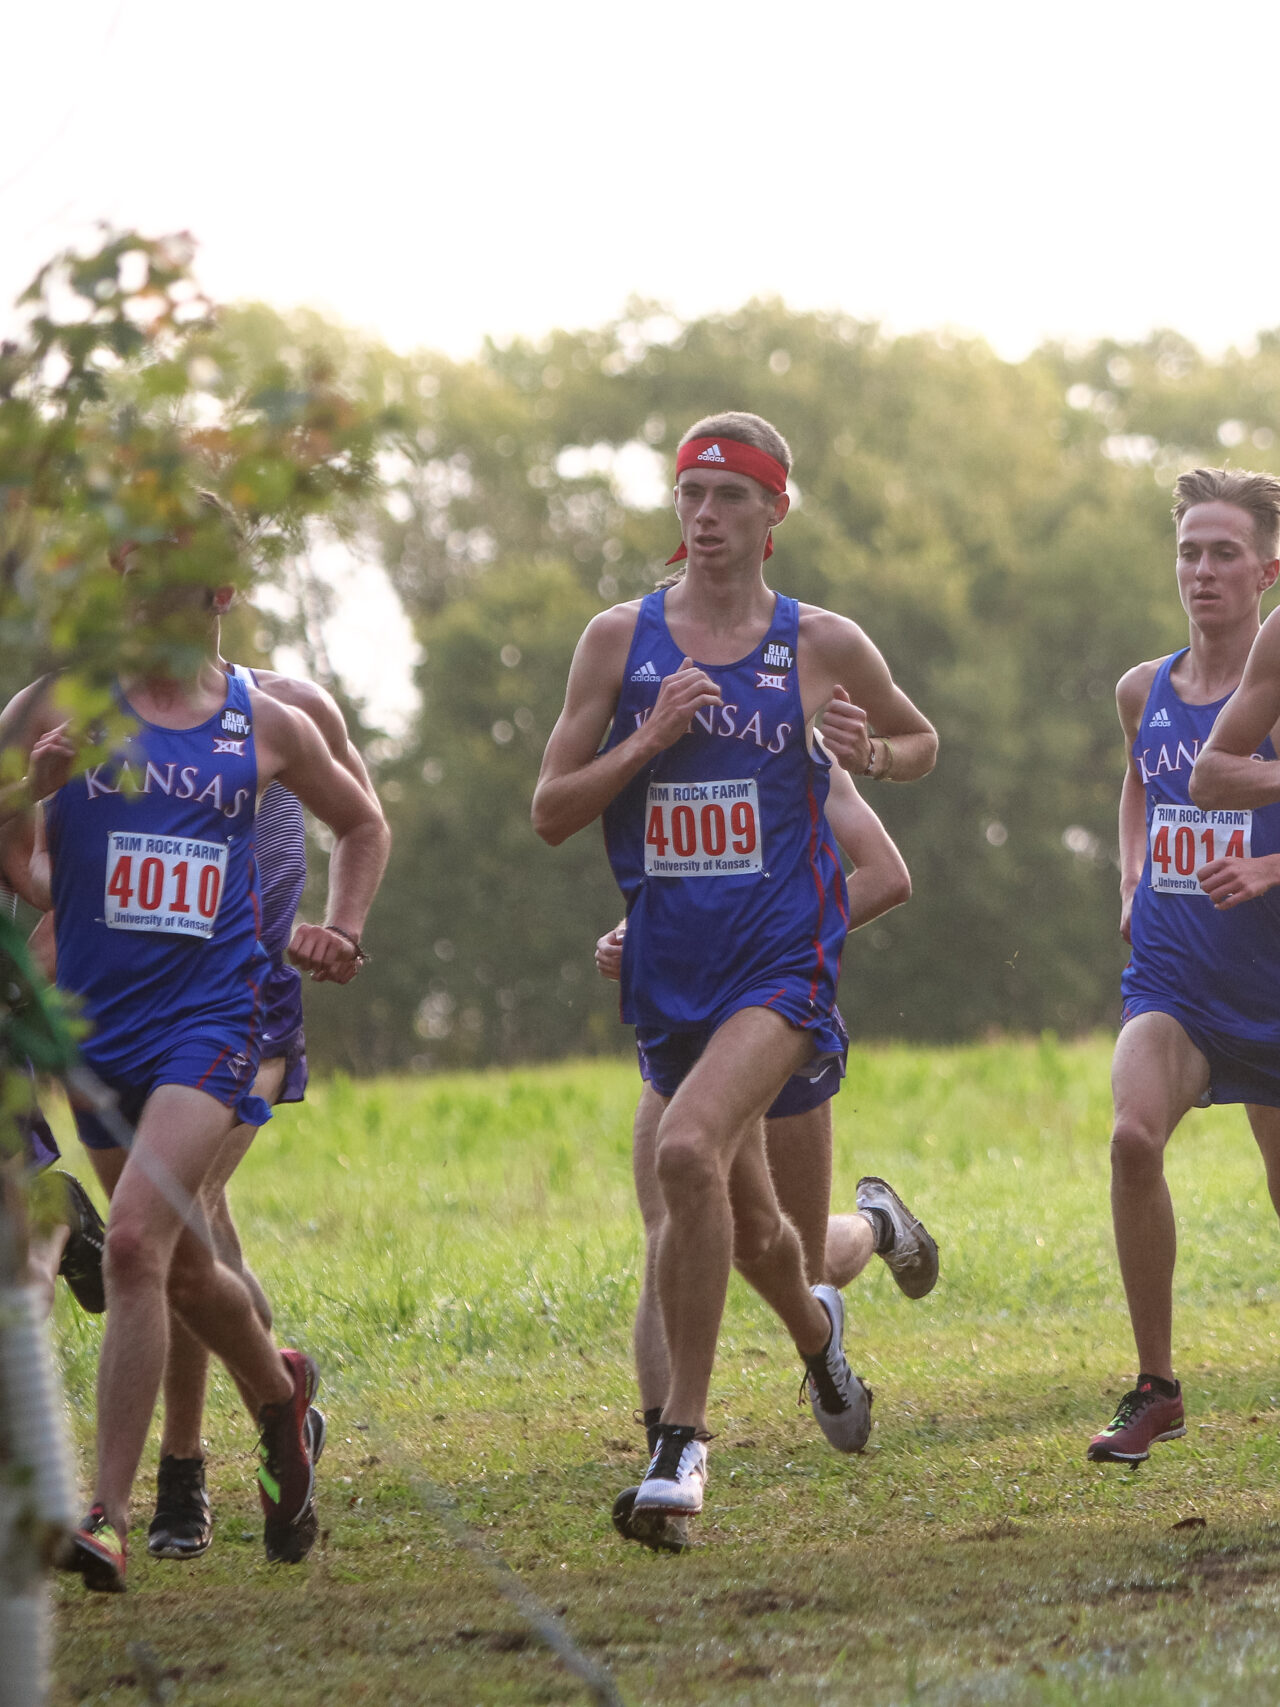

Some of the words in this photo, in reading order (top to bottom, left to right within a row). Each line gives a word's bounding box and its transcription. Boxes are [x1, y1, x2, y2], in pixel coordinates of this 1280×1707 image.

[697, 454, 725, 462] adidas
[768, 643, 789, 657] BLM
[763, 653, 793, 668] UNITY
[630, 674, 661, 682] adidas
[225, 710, 246, 725] BLM
[1149, 720, 1171, 728] adidas
[221, 719, 250, 735] UNITY
[634, 703, 792, 754] NSAS
[84, 759, 249, 818] KANSAS
[649, 787, 669, 801] RIM
[673, 786, 708, 801] ROCK
[712, 784, 749, 799] FARM
[1158, 808, 1177, 821] RIM
[1179, 809, 1208, 823] ROCK
[1211, 811, 1245, 825] FARM
[646, 801, 756, 857] 4009
[115, 836, 142, 851] RIM
[146, 838, 182, 855] ROCK
[185, 843, 220, 862] FARM
[653, 860, 700, 872] University
[703, 860, 713, 871] of
[715, 859, 750, 870] Kansas
[107, 855, 220, 918] 4010
[1158, 877, 1197, 890] University
[114, 912, 162, 927] University
[164, 916, 174, 926] of
[177, 917, 209, 932] Kansas
